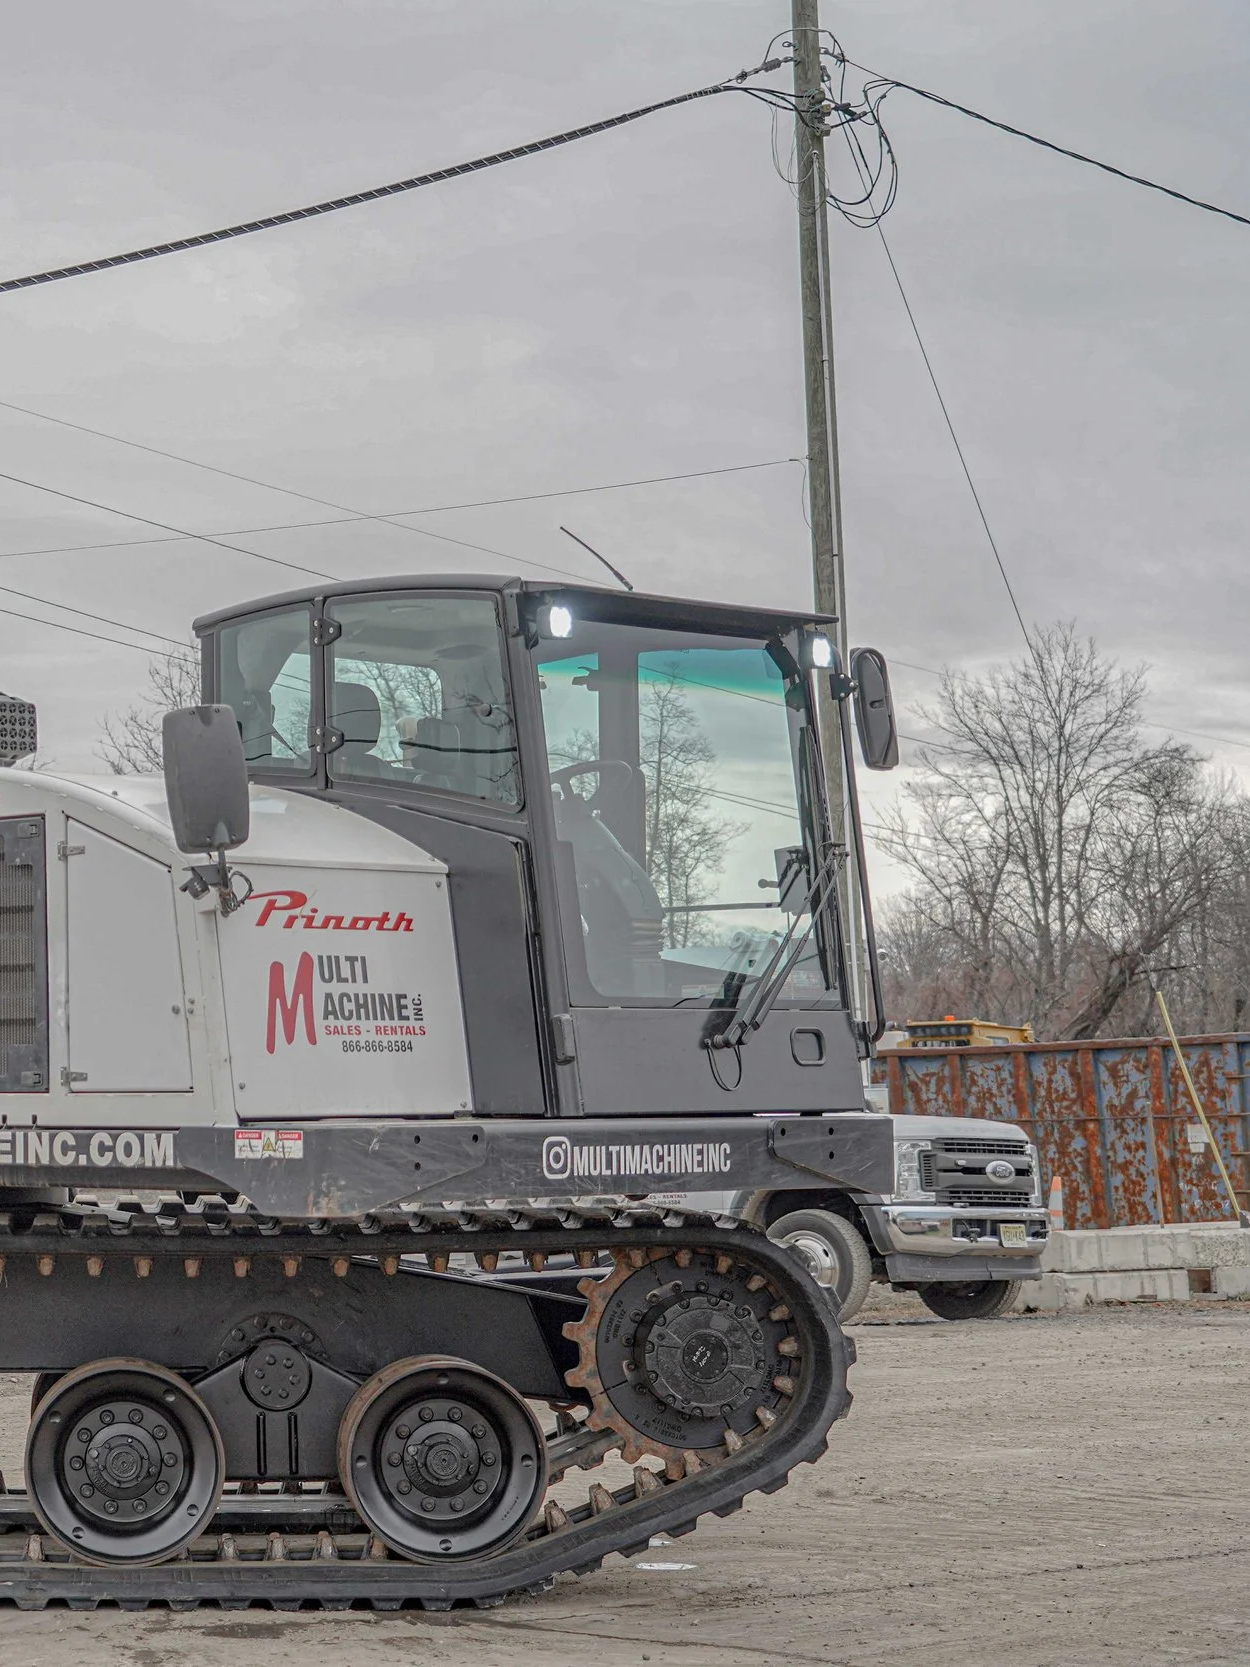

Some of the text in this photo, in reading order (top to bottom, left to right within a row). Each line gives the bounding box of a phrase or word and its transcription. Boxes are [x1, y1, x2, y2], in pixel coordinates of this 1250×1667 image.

[246, 890, 414, 932] Prinoth
[411, 993, 424, 1021] INC.
[324, 1025, 362, 1036] SALES
[375, 1025, 426, 1036] RENTALS
[573, 1142, 731, 1176] MULTIMACHINEINC
